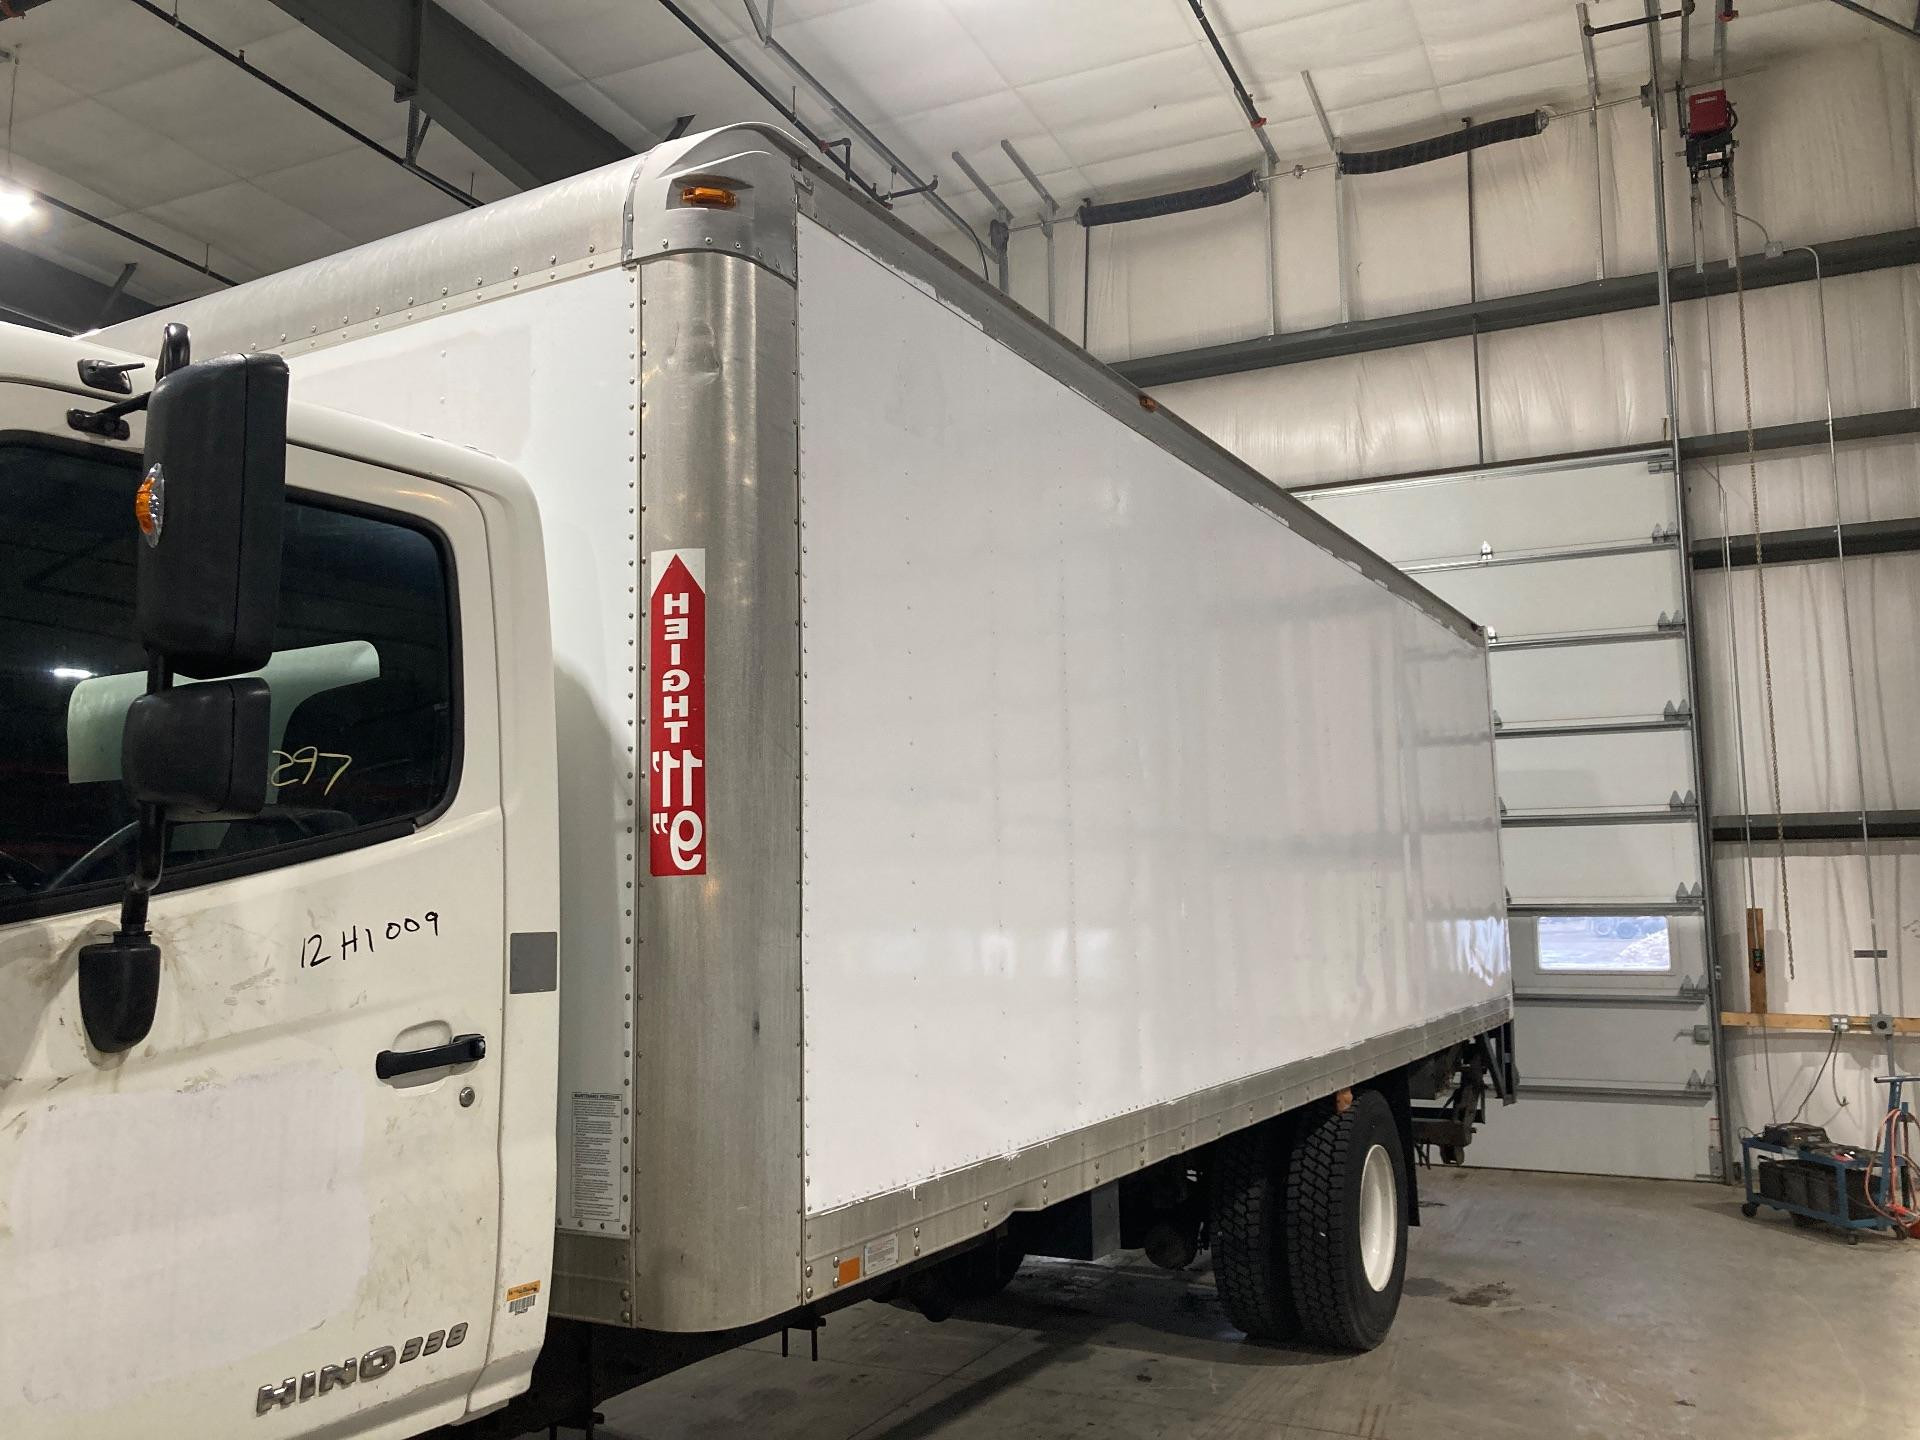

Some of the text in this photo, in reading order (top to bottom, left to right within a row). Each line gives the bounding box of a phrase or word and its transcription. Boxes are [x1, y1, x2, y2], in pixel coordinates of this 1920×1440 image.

[270, 745, 353, 797] 297
[256, 1321, 470, 1418] HINO 338
